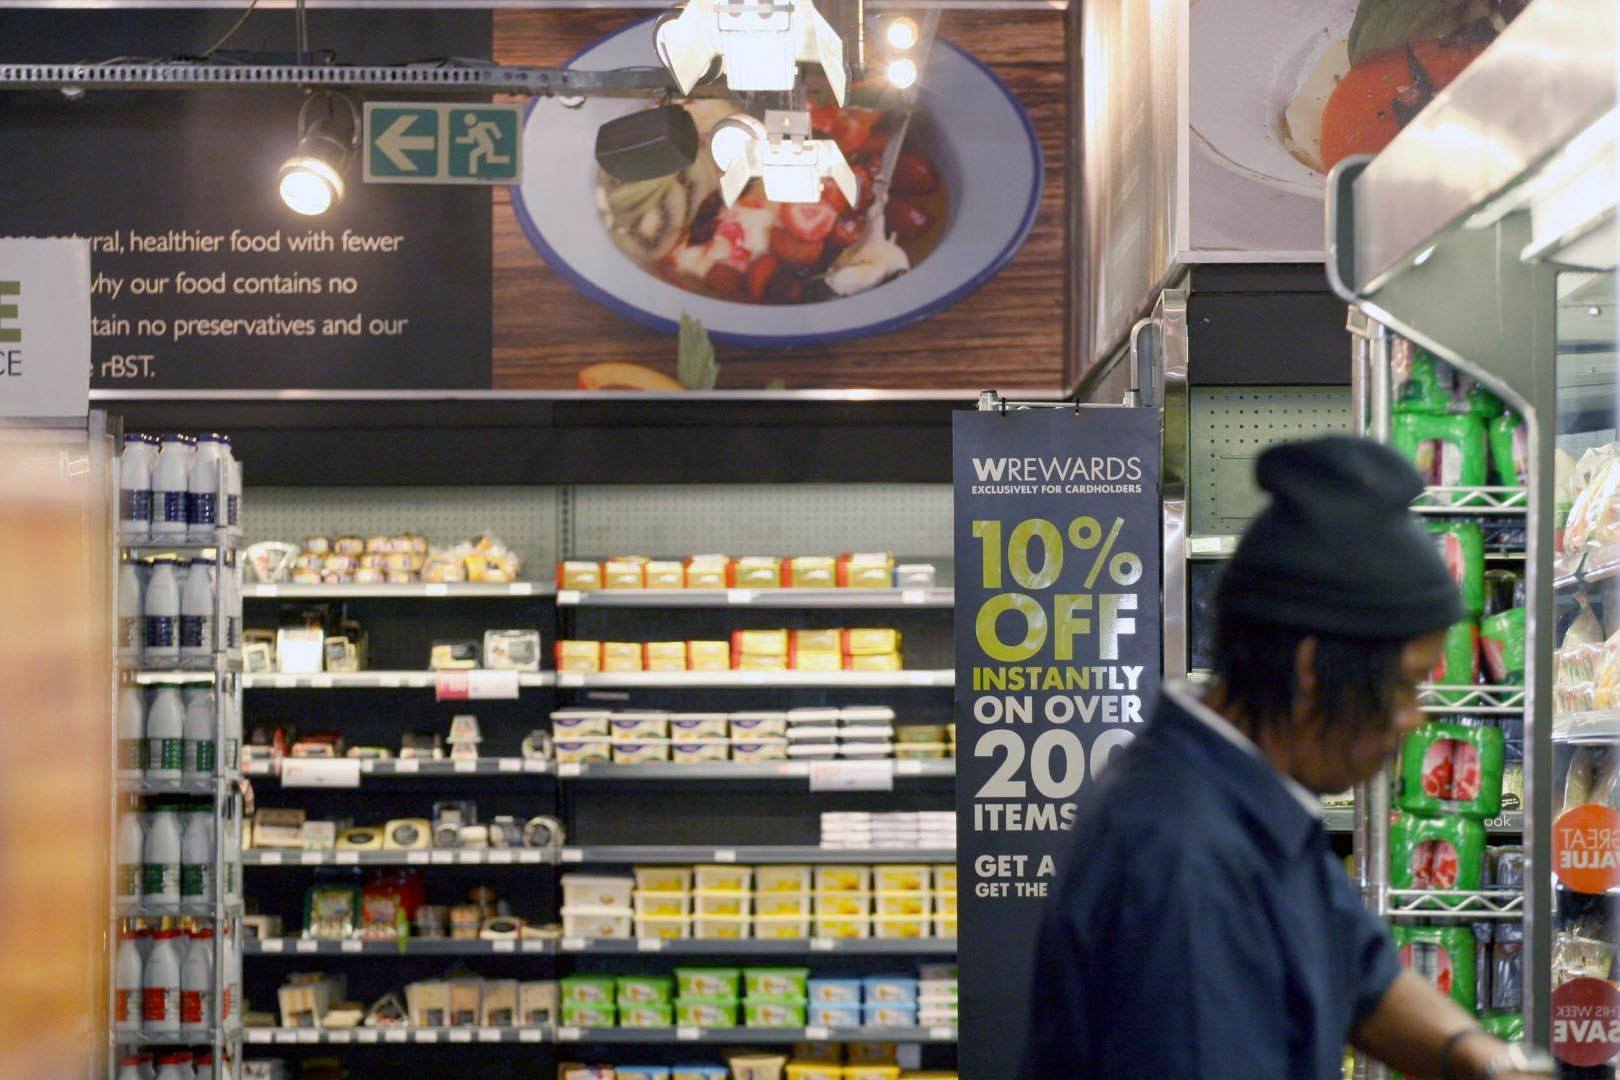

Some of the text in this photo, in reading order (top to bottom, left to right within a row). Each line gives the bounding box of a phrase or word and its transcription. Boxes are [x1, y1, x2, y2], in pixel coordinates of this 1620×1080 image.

[130, 229, 224, 253] healthier
[230, 229, 281, 253] food
[287, 229, 335, 253] with
[342, 229, 405, 253] fewer
[130, 277, 169, 295] our
[175, 271, 226, 295] food
[233, 271, 322, 295] contains
[328, 276, 358, 295] no
[91, 313, 408, 342] tain no preservatives and our
[101, 354, 156, 378] rBST.
[971, 484, 1142, 495] EXCLUSIVELY FOR CARDHOLDERS
[972, 515, 1143, 590] 10%
[975, 592, 1138, 663] OFF
[972, 665, 1145, 691] INSTANTLY
[973, 694, 1145, 725] ON OVER
[974, 803, 1079, 832] ITEMS
[974, 854, 1028, 878] GET
[975, 882, 1048, 898] GET THE
